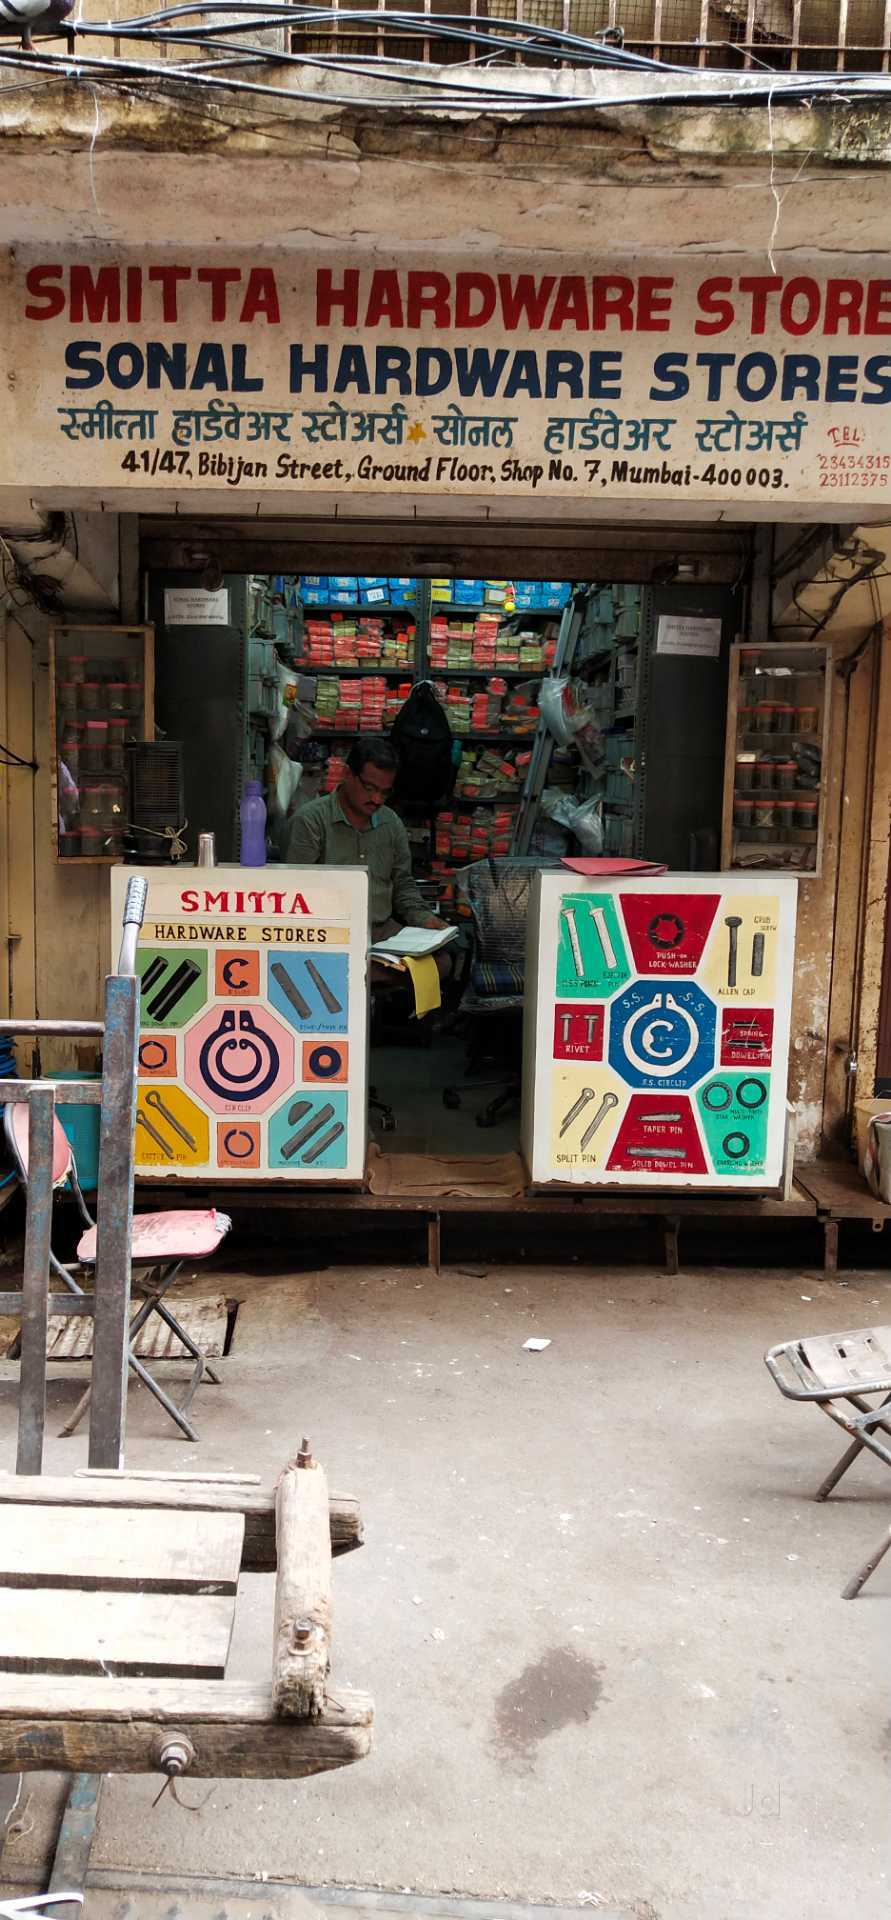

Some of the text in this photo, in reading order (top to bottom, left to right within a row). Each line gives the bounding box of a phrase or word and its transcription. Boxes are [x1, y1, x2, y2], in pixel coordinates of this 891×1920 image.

[25, 264, 891, 336] SMITTA HARDWARE STORE
[65, 340, 891, 405] SONAL HARDWARE STORES
[432, 403, 519, 449] सोनल
[121, 447, 193, 480] 41/47,
[198, 451, 268, 487] Bibijan
[275, 453, 352, 482] Street,
[357, 454, 432, 482] Ground
[500, 459, 544, 489] Shop
[548, 459, 578, 482] No.
[819, 472, 889, 487] 23112375
[180, 889, 313, 915] SMITTA
[155, 924, 328, 943] HARDWARE STORES
[718, 988, 756, 997] ALLEN CAP
[565, 1045, 591, 1054] RIVET
[643, 1125, 684, 1135] TAPER PIN
[556, 1153, 597, 1163] SPLIT PIN
